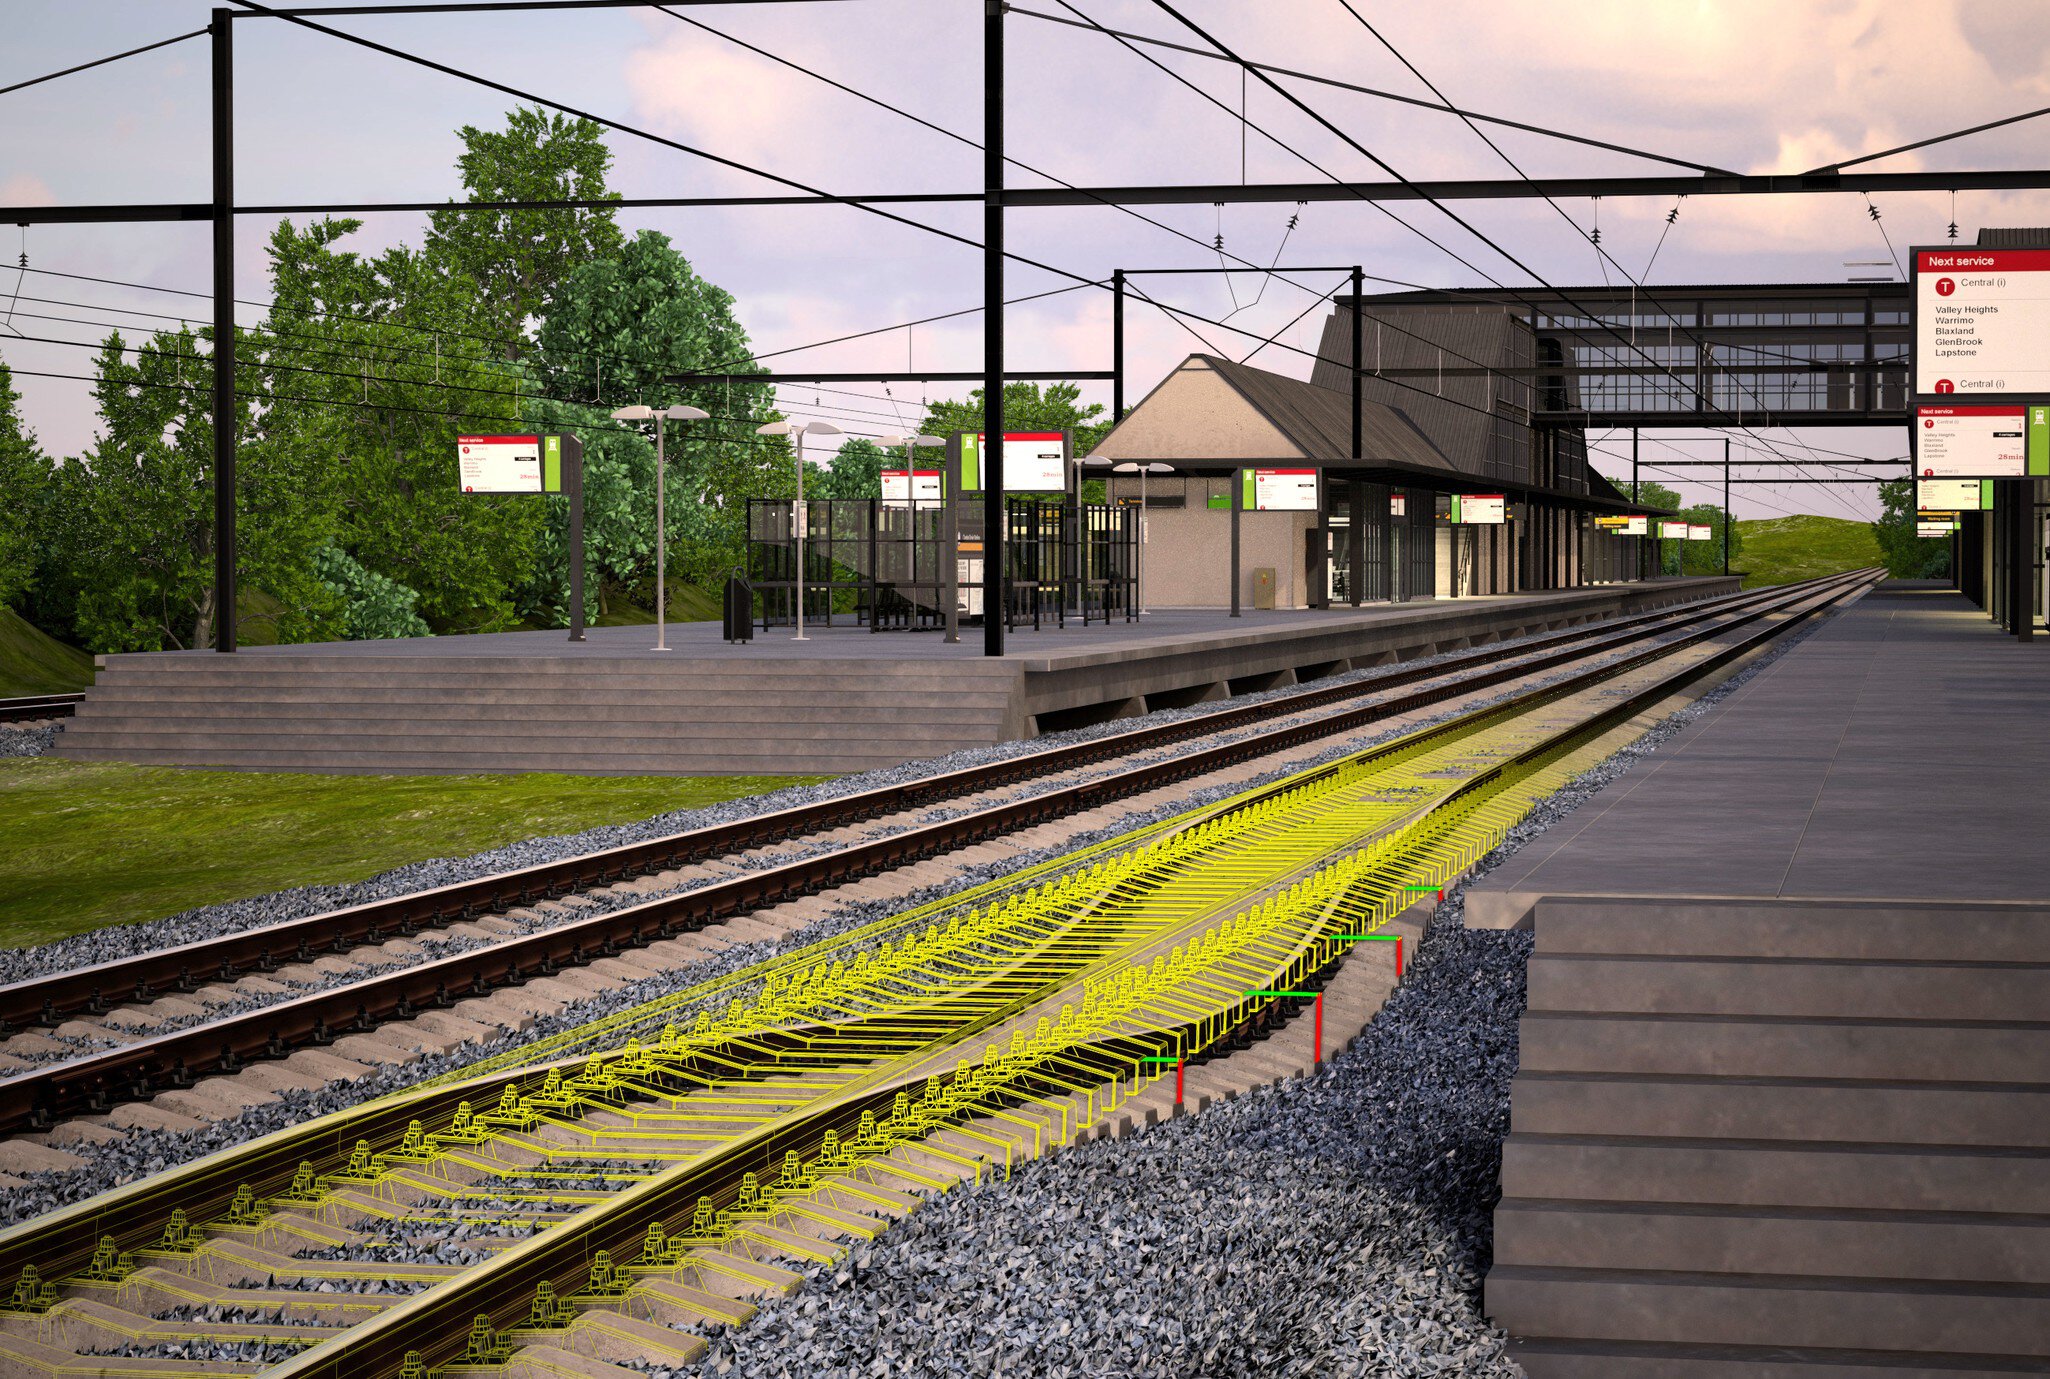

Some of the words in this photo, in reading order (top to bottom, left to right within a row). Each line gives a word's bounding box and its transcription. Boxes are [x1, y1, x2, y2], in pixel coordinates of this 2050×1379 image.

[1928, 256, 1954, 267] Next
[1956, 255, 1995, 266] service
[1961, 278, 1995, 287] Central
[1997, 278, 2006, 288] (i)
[1935, 306, 1962, 315] Valley
[1964, 305, 1999, 315] Heights
[1935, 317, 1975, 325] Warrimo
[1935, 327, 1975, 335] Blaxland
[1935, 338, 1983, 346] GlenBrook
[1935, 349, 1977, 358] Lapstone
[1960, 379, 1994, 388] Central
[1996, 380, 2005, 389] (i)
